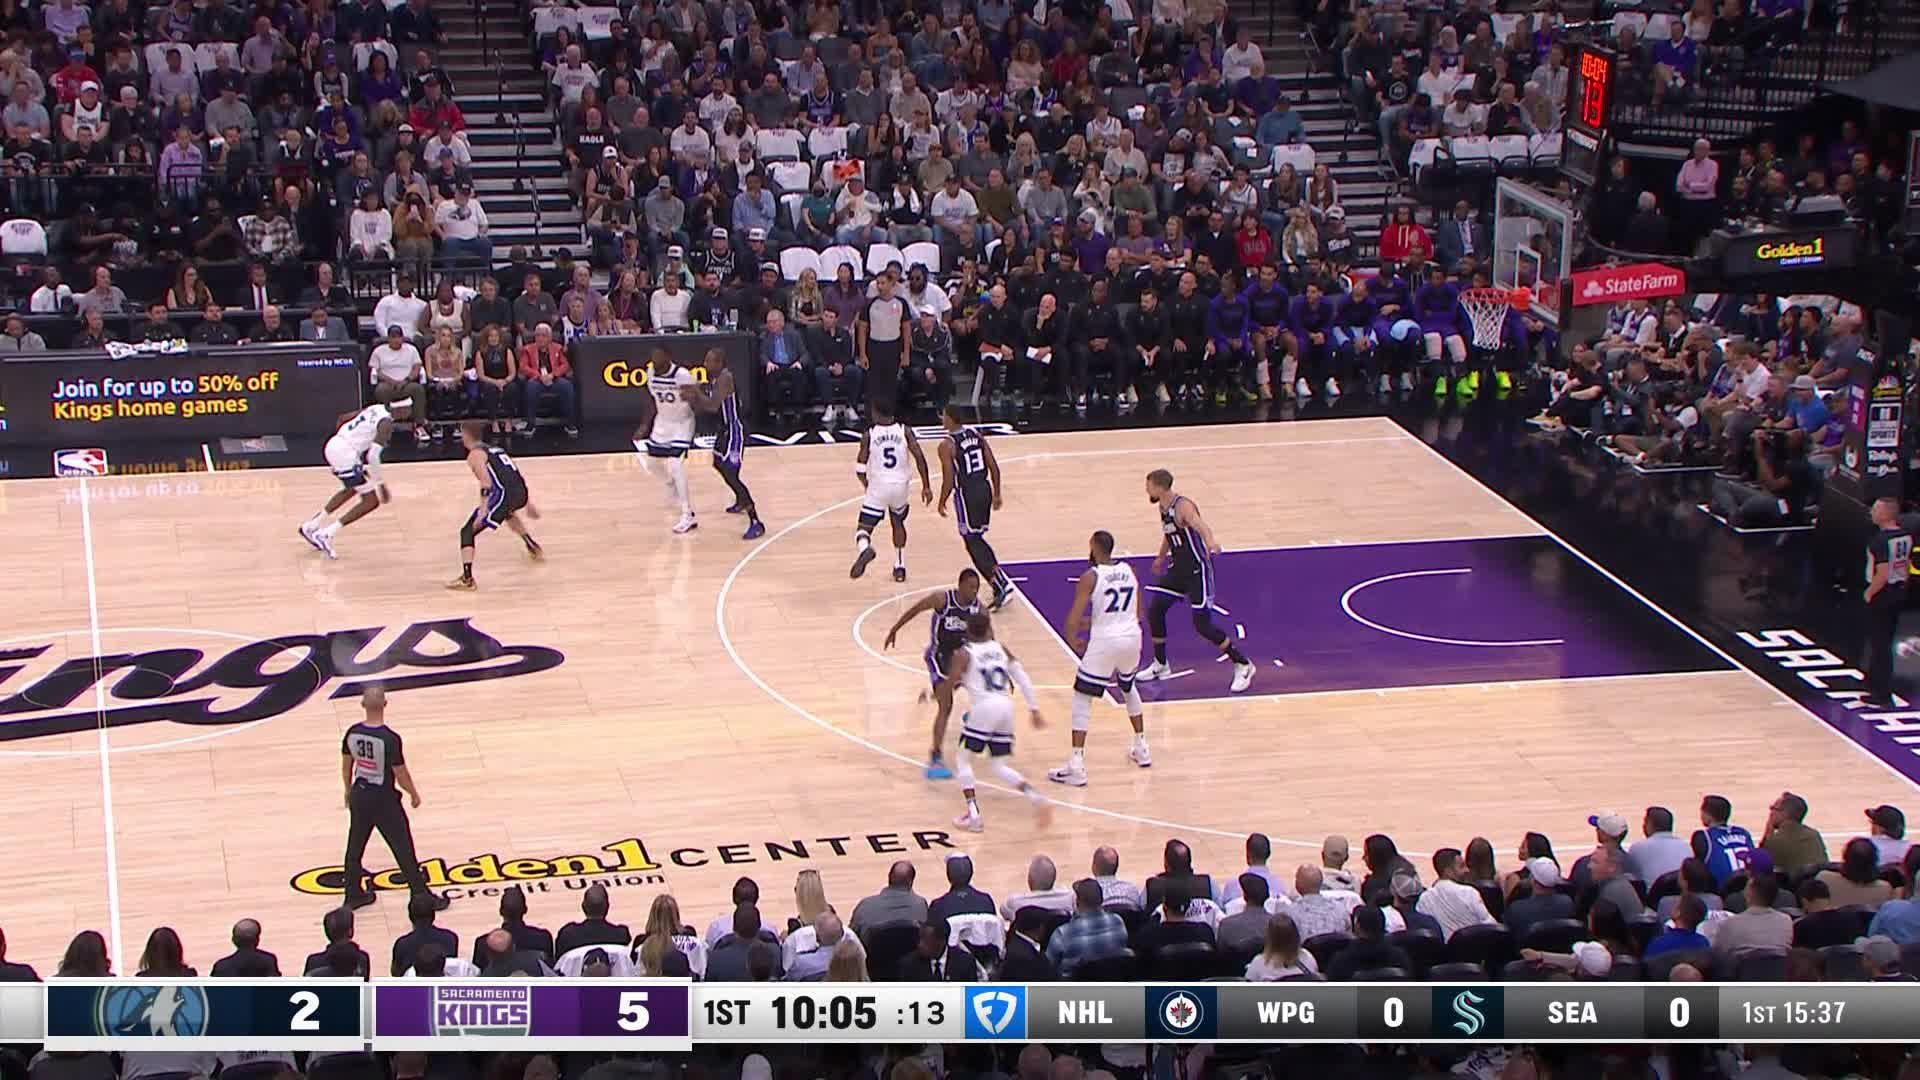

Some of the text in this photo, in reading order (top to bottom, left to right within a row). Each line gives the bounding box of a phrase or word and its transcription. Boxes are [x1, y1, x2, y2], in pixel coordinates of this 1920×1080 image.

[1582, 52, 1607, 83] 10:04
[1583, 80, 1603, 129] 13
[53, 371, 280, 399] Join for up to 50% off
[54, 397, 249, 421] Kings home games
[883, 447, 897, 469] 5
[963, 449, 987, 475] 13
[1104, 586, 1134, 613] 27
[670, 831, 957, 867] CENTER
